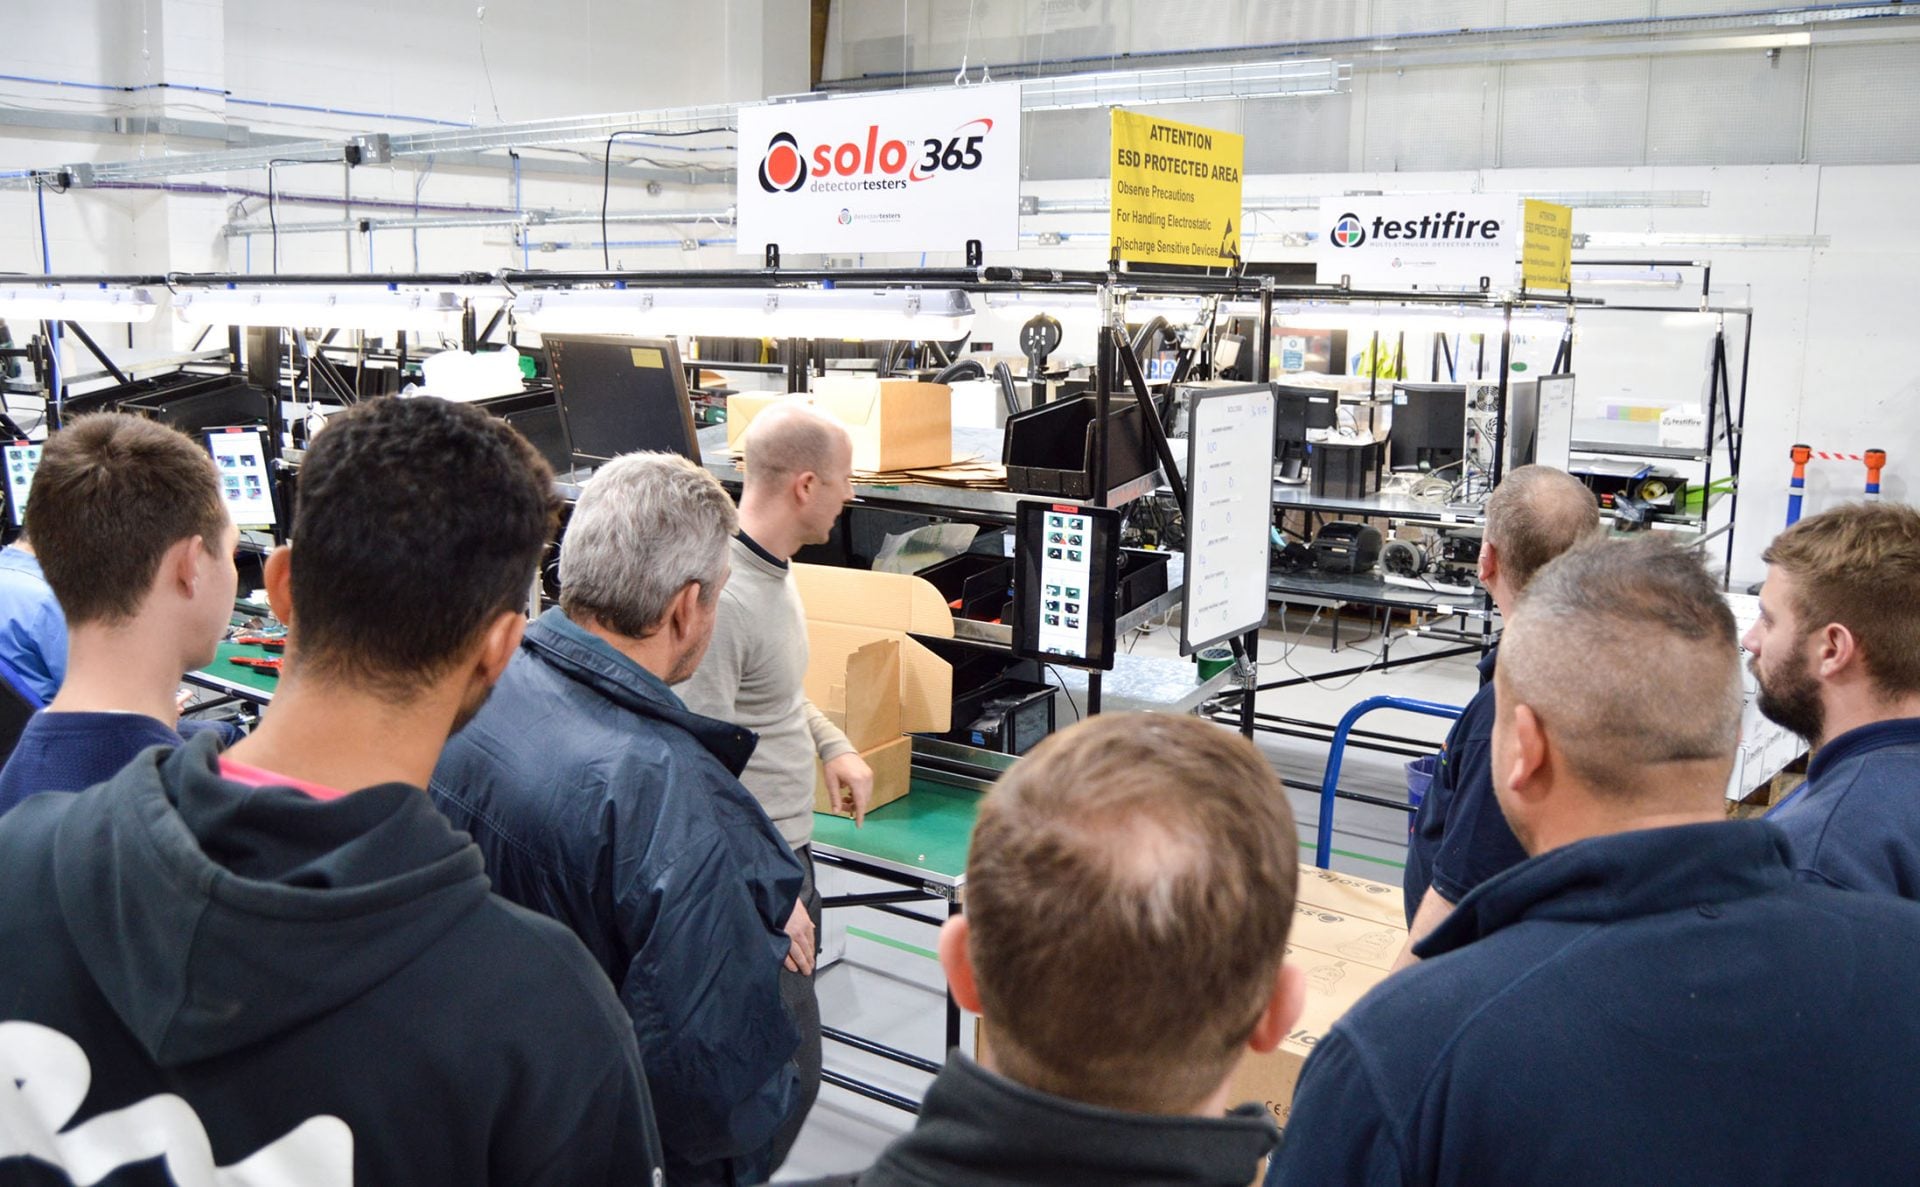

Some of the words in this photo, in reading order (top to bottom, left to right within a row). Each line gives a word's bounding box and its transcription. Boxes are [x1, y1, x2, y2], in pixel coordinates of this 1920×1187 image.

[1150, 124, 1212, 151] ATTENTION
[811, 125, 907, 177] solo
[920, 136, 984, 172] 365
[1118, 148, 1140, 168] ESD
[1144, 153, 1208, 178] PROTECTED
[1211, 165, 1239, 183] AREA
[810, 179, 907, 193] detectortesters
[1117, 180, 1150, 197] Observe
[1152, 185, 1195, 203] Precautions
[1117, 208, 1130, 223] For
[1132, 210, 1166, 230] Handling
[1168, 214, 1211, 231] Electrostatic
[1372, 211, 1500, 240] testifire
[1116, 236, 1155, 255] Discharge
[1157, 240, 1190, 255] Sensitive
[1192, 243, 1219, 257] Devices
